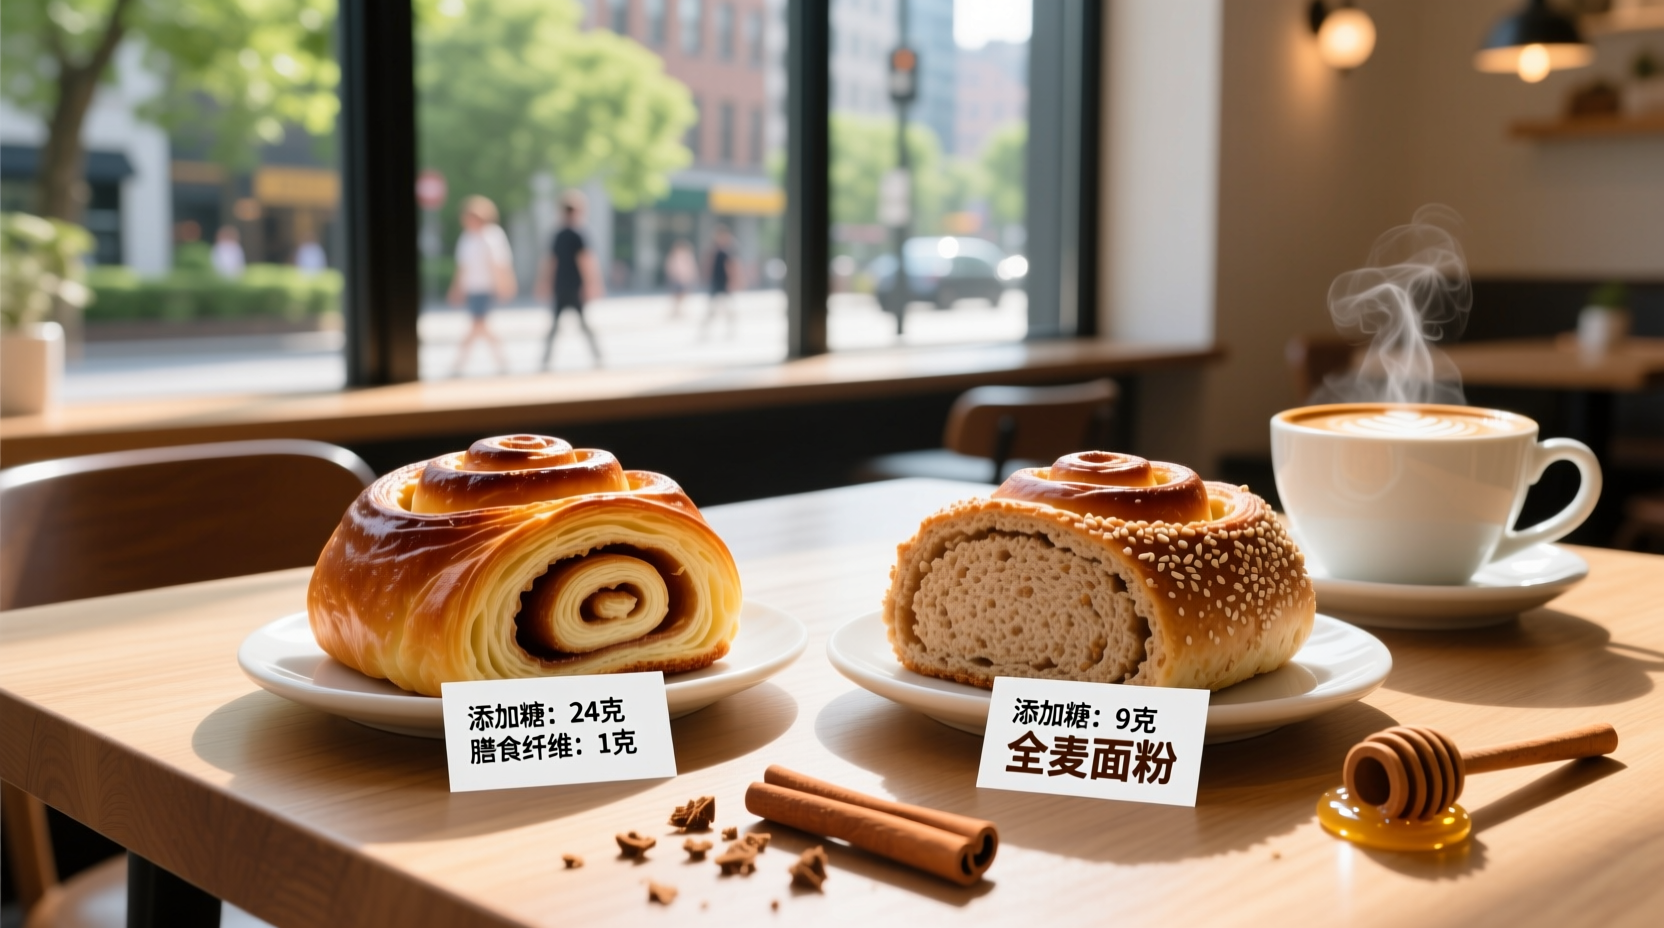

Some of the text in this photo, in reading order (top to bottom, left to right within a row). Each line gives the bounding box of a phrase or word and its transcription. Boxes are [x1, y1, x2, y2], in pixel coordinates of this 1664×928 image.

[468, 697, 625, 731] 添加糖：24克
[1012, 697, 1158, 733] 添加糖：9克
[471, 728, 637, 764] 膳食纤维：1克
[1005, 730, 1177, 785] 全麦面粉
